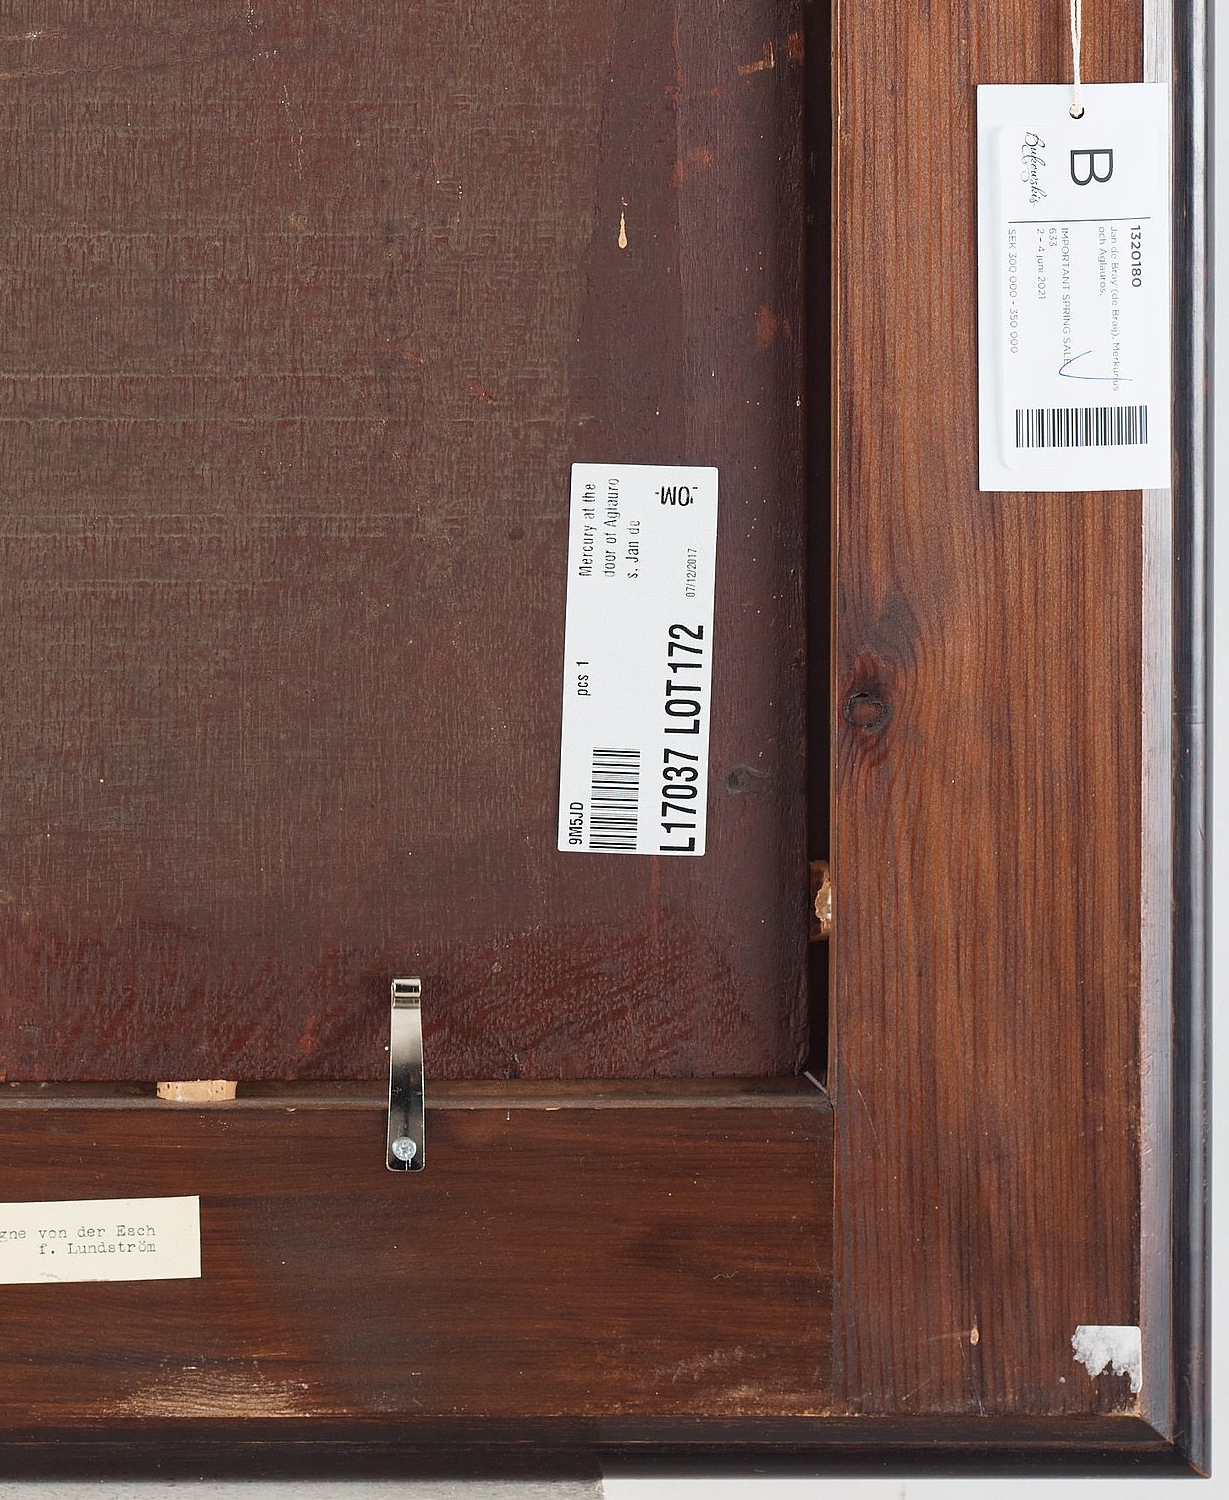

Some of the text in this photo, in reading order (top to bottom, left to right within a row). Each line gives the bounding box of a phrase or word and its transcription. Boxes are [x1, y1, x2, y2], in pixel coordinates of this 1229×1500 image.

[1021, 131, 1046, 206] Bukowskis
[1071, 148, 1113, 186] B
[1008, 229, 1017, 249] SEK
[1048, 228, 1057, 247] 633
[1098, 226, 1107, 245] och
[1109, 226, 1119, 244] Jan
[1008, 253, 1018, 273] 300
[1036, 254, 1046, 274] juni
[1110, 247, 1120, 260] de
[1130, 225, 1142, 288] 1320180
[1109, 262, 1120, 286] Bray
[1009, 276, 1018, 298] 000
[1037, 276, 1046, 300] 2021
[1060, 227, 1072, 365] IMPORTANT SPRING SALE
[1110, 289, 1120, 307] (de
[1009, 308, 1018, 327] 350
[1010, 331, 1019, 353] 000
[1111, 342, 1121, 392] Merkurius
[579, 484, 597, 576] Mercury at the
[603, 478, 620, 577] door of Aglauro
[627, 520, 640, 535] de
[625, 541, 639, 563] Jan
[686, 548, 697, 597] 07/12/2017
[577, 673, 591, 696] pcs
[660, 748, 700, 851] L17037
[569, 802, 584, 845] 9M5JD
[38, 1229, 67, 1240] von
[77, 1226, 106, 1238] der
[116, 1225, 156, 1237] Esch
[39, 1241, 156, 1255] f. Lundström
